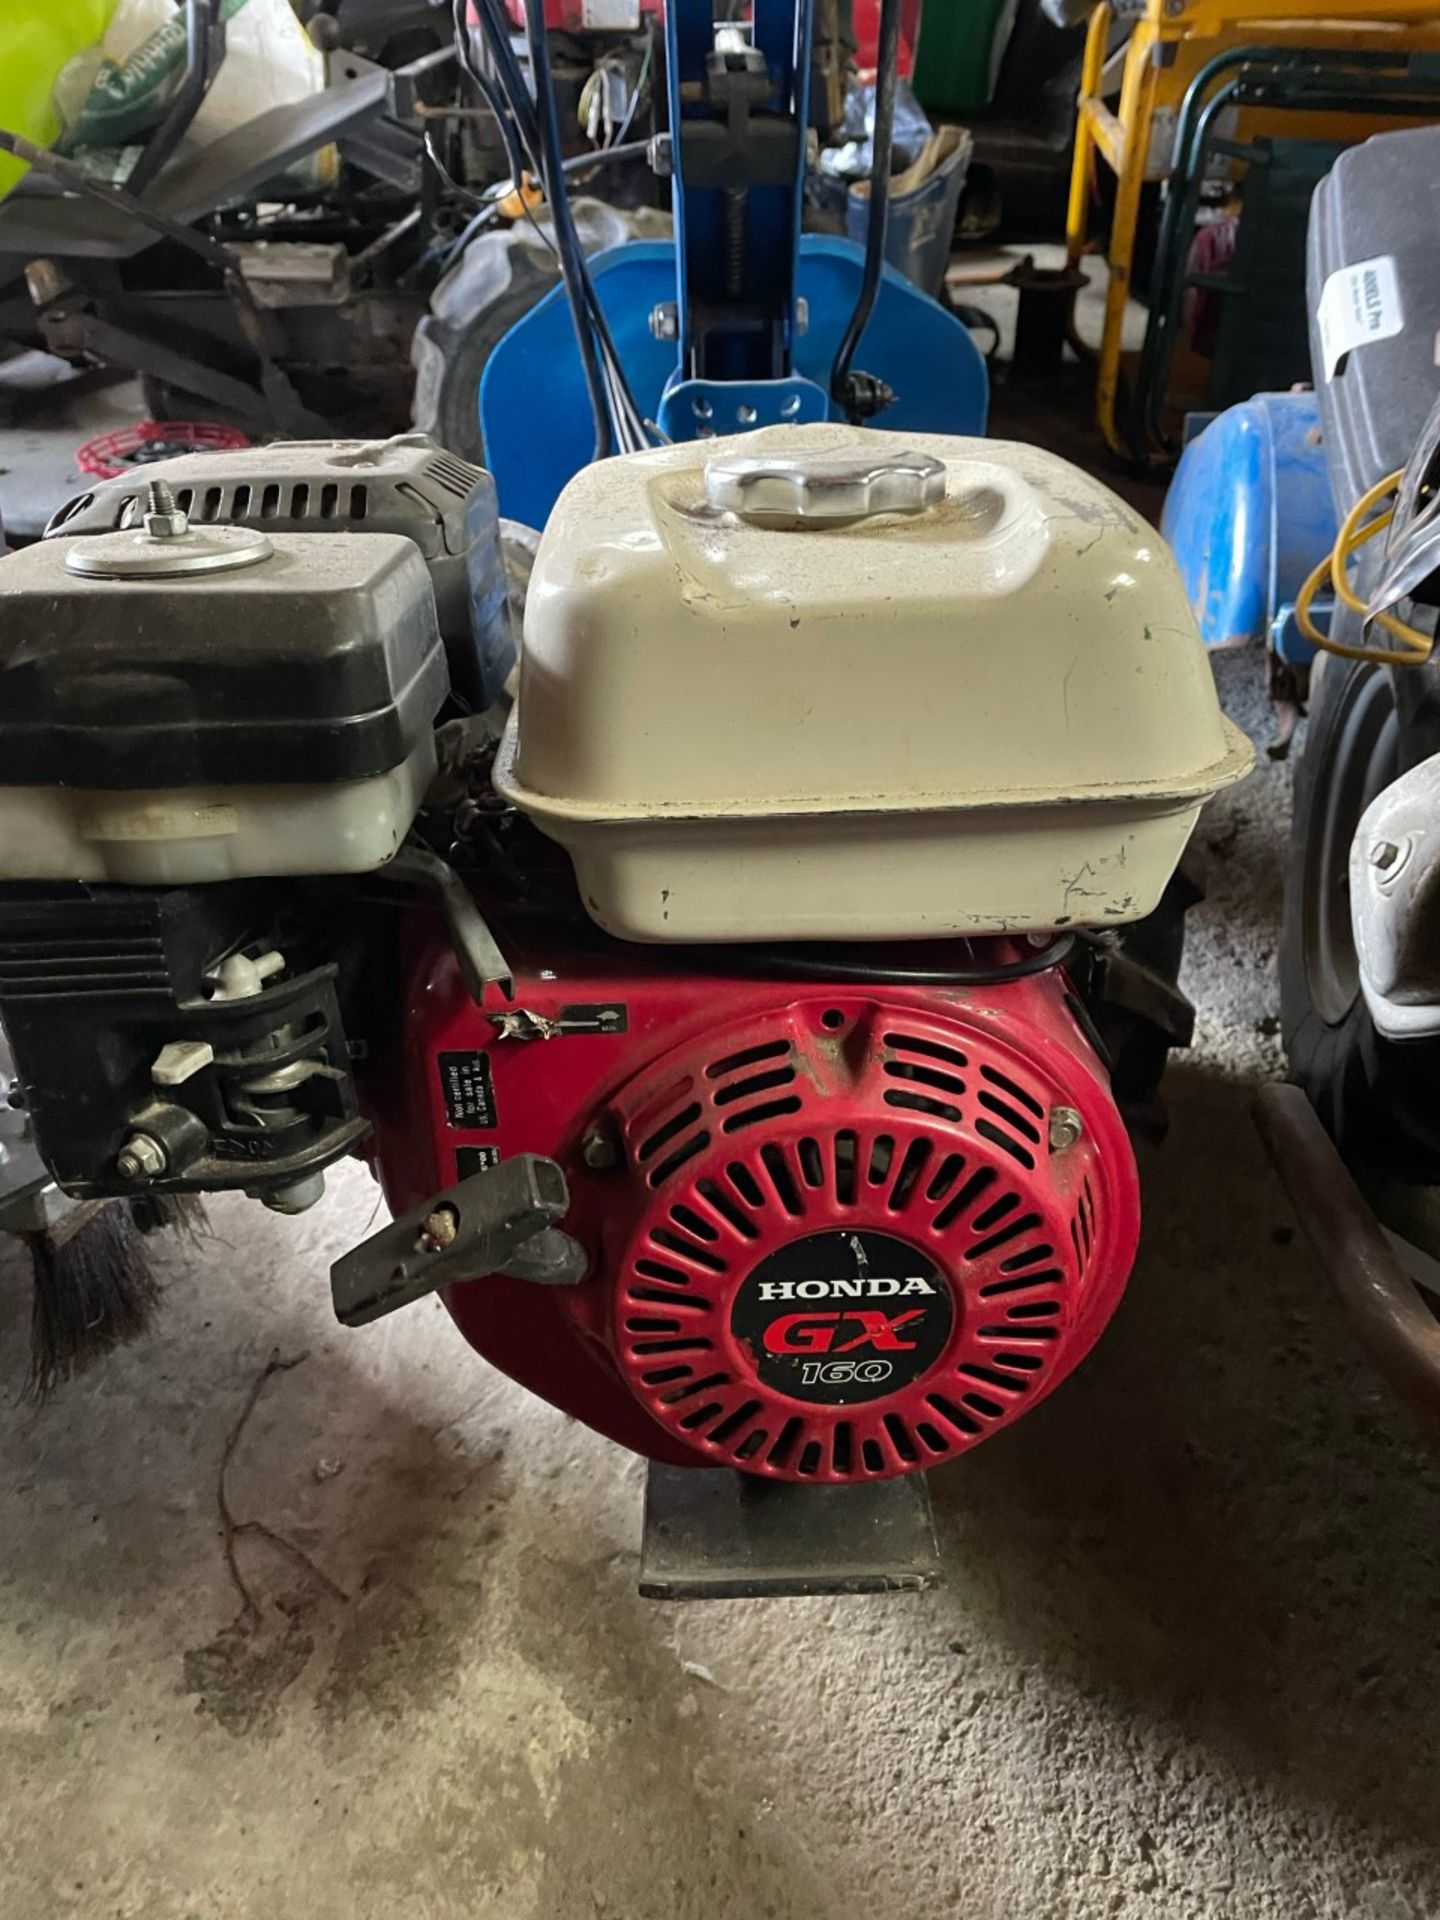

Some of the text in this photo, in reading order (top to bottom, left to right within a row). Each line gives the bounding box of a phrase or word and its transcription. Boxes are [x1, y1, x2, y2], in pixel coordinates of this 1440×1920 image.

[449, 1066, 465, 1119] Not certified
[461, 1066, 476, 1114] for sale in
[758, 1277, 937, 1301] HONDA
[762, 1308, 928, 1354] GX
[801, 1359, 893, 1385] 160
